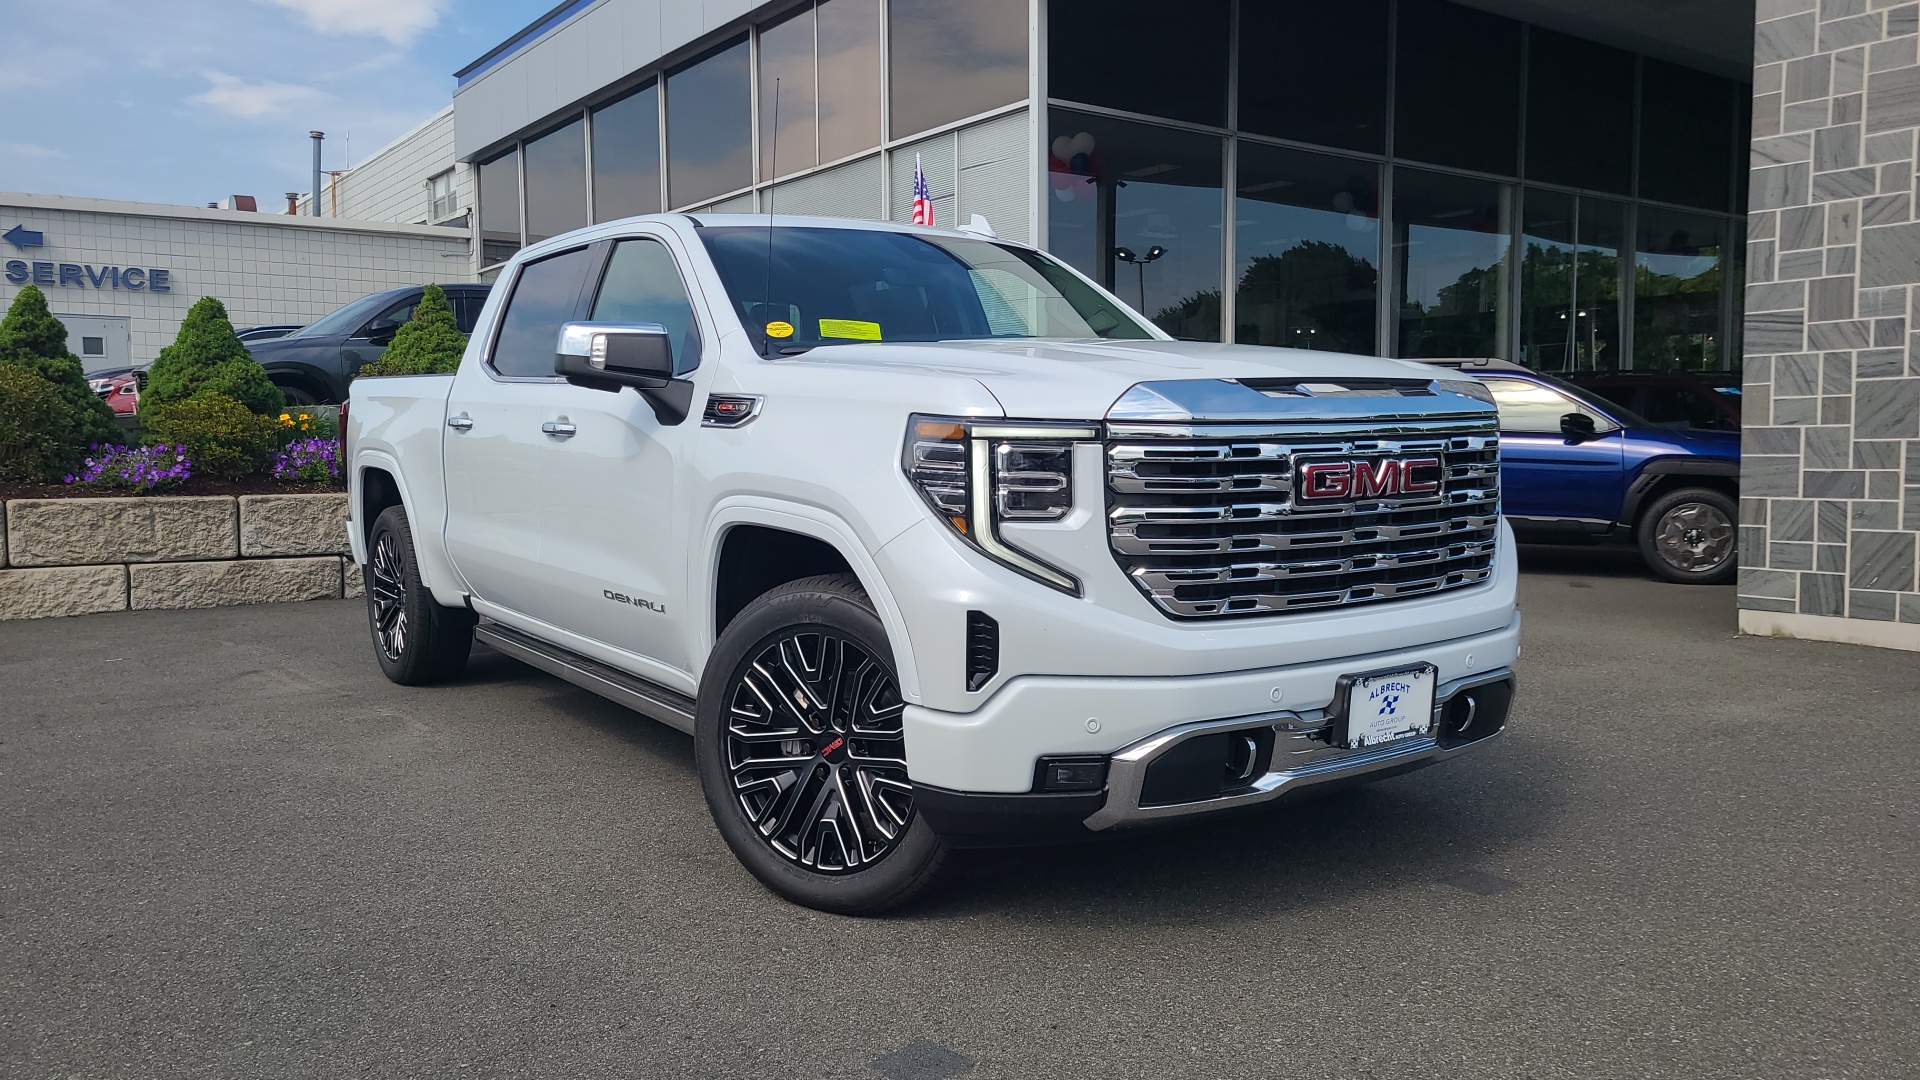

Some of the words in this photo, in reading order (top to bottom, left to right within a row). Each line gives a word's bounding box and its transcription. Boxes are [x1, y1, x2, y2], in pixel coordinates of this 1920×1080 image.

[5, 260, 171, 291] SERVICE
[1301, 458, 1438, 499] GMC
[603, 589, 666, 614] DENALI
[1369, 682, 1411, 701] ALBRECHT
[1370, 720, 1385, 728] AUTO
[1386, 716, 1405, 725] GROUP
[1364, 731, 1395, 746] Albrecht
